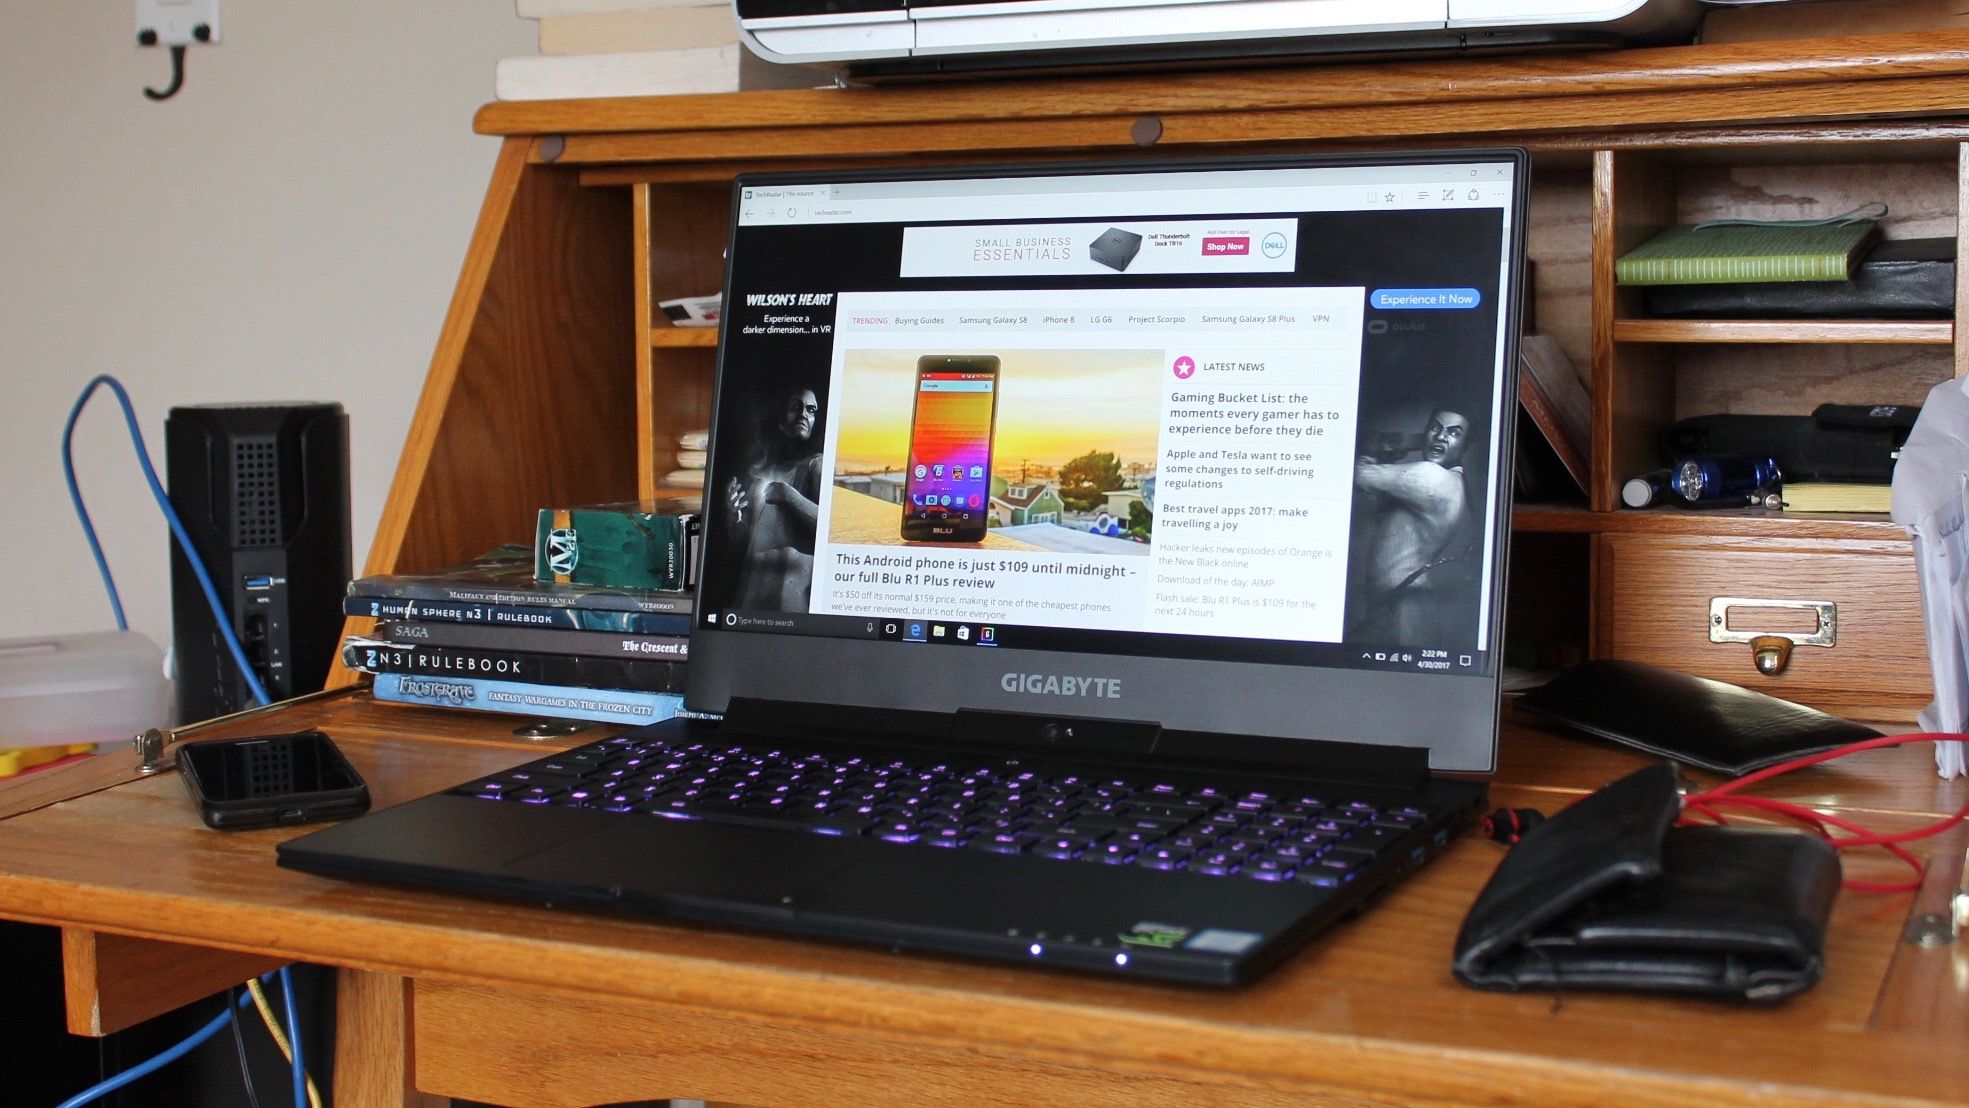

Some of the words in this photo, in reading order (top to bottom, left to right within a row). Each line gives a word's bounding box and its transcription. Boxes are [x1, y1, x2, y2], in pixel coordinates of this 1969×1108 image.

[975, 239, 1011, 248] SMALL
[1016, 237, 1072, 247] BUSINESS
[1207, 242, 1226, 251] Shop
[1227, 241, 1245, 250] Now
[1264, 241, 1285, 249] DELL
[973, 247, 1071, 261] ESSENTIALS
[746, 294, 797, 306] WILSON'S
[798, 293, 833, 306] HEART
[1381, 294, 1437, 306] Experience
[1448, 294, 1473, 304] Now
[764, 314, 803, 325] Experience
[852, 317, 888, 325] TRENDING
[894, 316, 919, 326] Buying
[920, 316, 945, 325] Guides
[959, 316, 992, 326] Samsung
[993, 316, 1017, 326] Galaxy
[1043, 316, 1069, 324] iPhone
[1128, 315, 1155, 325] Project
[1157, 315, 1186, 325] Scorpio
[1201, 315, 1238, 324] Samsung
[1239, 315, 1266, 324] Galaxy
[1279, 315, 1296, 323] Plus
[743, 325, 766, 334] darker
[767, 325, 810, 334] dimension...
[820, 325, 832, 333] VR
[1203, 363, 1236, 371] LATEST
[1238, 363, 1266, 372] NEWS
[1171, 392, 1215, 405] Gaming
[1218, 392, 1258, 403] Bucket
[1261, 393, 1285, 404] List:
[1289, 393, 1309, 404] the
[1170, 408, 1224, 419] moments
[1227, 410, 1259, 422] every
[1262, 410, 1300, 422] gamer
[1303, 409, 1324, 420] has
[1327, 411, 1340, 420] to
[1169, 424, 1232, 437] experience
[1234, 424, 1273, 436] before
[1276, 425, 1302, 438] they
[1305, 425, 1324, 436] die
[1167, 449, 1196, 461] Apple
[1199, 450, 1218, 460] and
[1221, 450, 1248, 460] Tesla
[1250, 452, 1277, 461] want
[1280, 452, 1291, 461] to
[1294, 453, 1312, 461] see
[1165, 465, 1194, 474] some
[1196, 465, 1238, 477] changes
[1241, 466, 1252, 475] to
[1254, 466, 1315, 479] self-driving
[1164, 479, 1223, 490] regulations
[1163, 504, 1186, 514] Best
[1188, 504, 1219, 514] travel
[1221, 507, 1246, 517] apps
[1249, 506, 1276, 517] 2017:
[1278, 507, 1309, 518] make
[1161, 518, 1211, 531] travelling
[1221, 520, 1239, 532] joy
[1159, 543, 1190, 552] Hacker
[1192, 543, 1214, 553] leaks
[1216, 546, 1235, 554] new
[1236, 546, 1276, 557] episodes
[1289, 547, 1323, 560] Orange
[836, 553, 861, 566] This
[863, 555, 913, 568] Android
[915, 557, 955, 571] phone
[958, 558, 968, 570] is
[970, 559, 996, 574] just
[999, 560, 1029, 573] $109
[1032, 562, 1063, 574] until
[1066, 563, 1126, 580] midnight
[1158, 556, 1173, 566] the
[1175, 557, 1195, 566] New
[1196, 558, 1219, 568] Black
[1221, 559, 1249, 569] online
[834, 572, 855, 582] our
[858, 571, 879, 584] full
[882, 573, 901, 585] Blu
[905, 574, 920, 585] R1
[923, 575, 949, 587] Plus
[952, 577, 995, 589] review
[1157, 574, 1201, 585] Download
[1214, 577, 1229, 587] the
[1231, 577, 1250, 589] day:
[1251, 578, 1275, 588] AIMP
[449, 591, 485, 601] MALIFAUX
[498, 594, 526, 603] EDITION
[527, 596, 547, 604] RULES
[548, 596, 577, 605] MANUAL
[845, 590, 860, 599] $50
[884, 593, 913, 602] normal
[915, 594, 934, 603] $159
[959, 596, 989, 608] making
[997, 599, 1014, 607] one
[1025, 599, 1039, 609] the
[1040, 600, 1079, 611] cheapest
[1080, 601, 1112, 612] phones
[1155, 593, 1178, 603] Flash
[1180, 594, 1200, 604] sale:
[1202, 595, 1217, 605] Blu
[1219, 596, 1229, 605] R1
[1232, 596, 1251, 606] Plus
[1262, 597, 1285, 608] $109
[382, 605, 418, 615] HUMAN
[422, 606, 462, 618] SPHERE
[466, 608, 482, 619] N3
[497, 612, 552, 624] RULEBOOK
[873, 605, 910, 615] reviewed,
[969, 610, 1006, 620] everyone
[1155, 607, 1174, 616] next
[1189, 608, 1214, 618] hours
[739, 616, 752, 625] Type
[753, 617, 766, 625] here
[775, 619, 794, 627] search
[395, 626, 429, 638] SAGA
[622, 640, 640, 652] The
[640, 641, 679, 654] Crescent
[679, 644, 689, 655] &
[1436, 650, 1448, 658] PM
[419, 654, 521, 674] RULEBOOK
[1416, 660, 1451, 670] 4/30/2017
[1000, 672, 1121, 699] GIGABYTE
[488, 691, 523, 703] FANTASY
[525, 695, 566, 707] WARGAMES
[568, 699, 578, 708] IN
[580, 700, 596, 710] THE
[598, 702, 631, 713] FROZEN
[632, 705, 653, 715] CITY
[675, 709, 697, 719] JOSEPH
